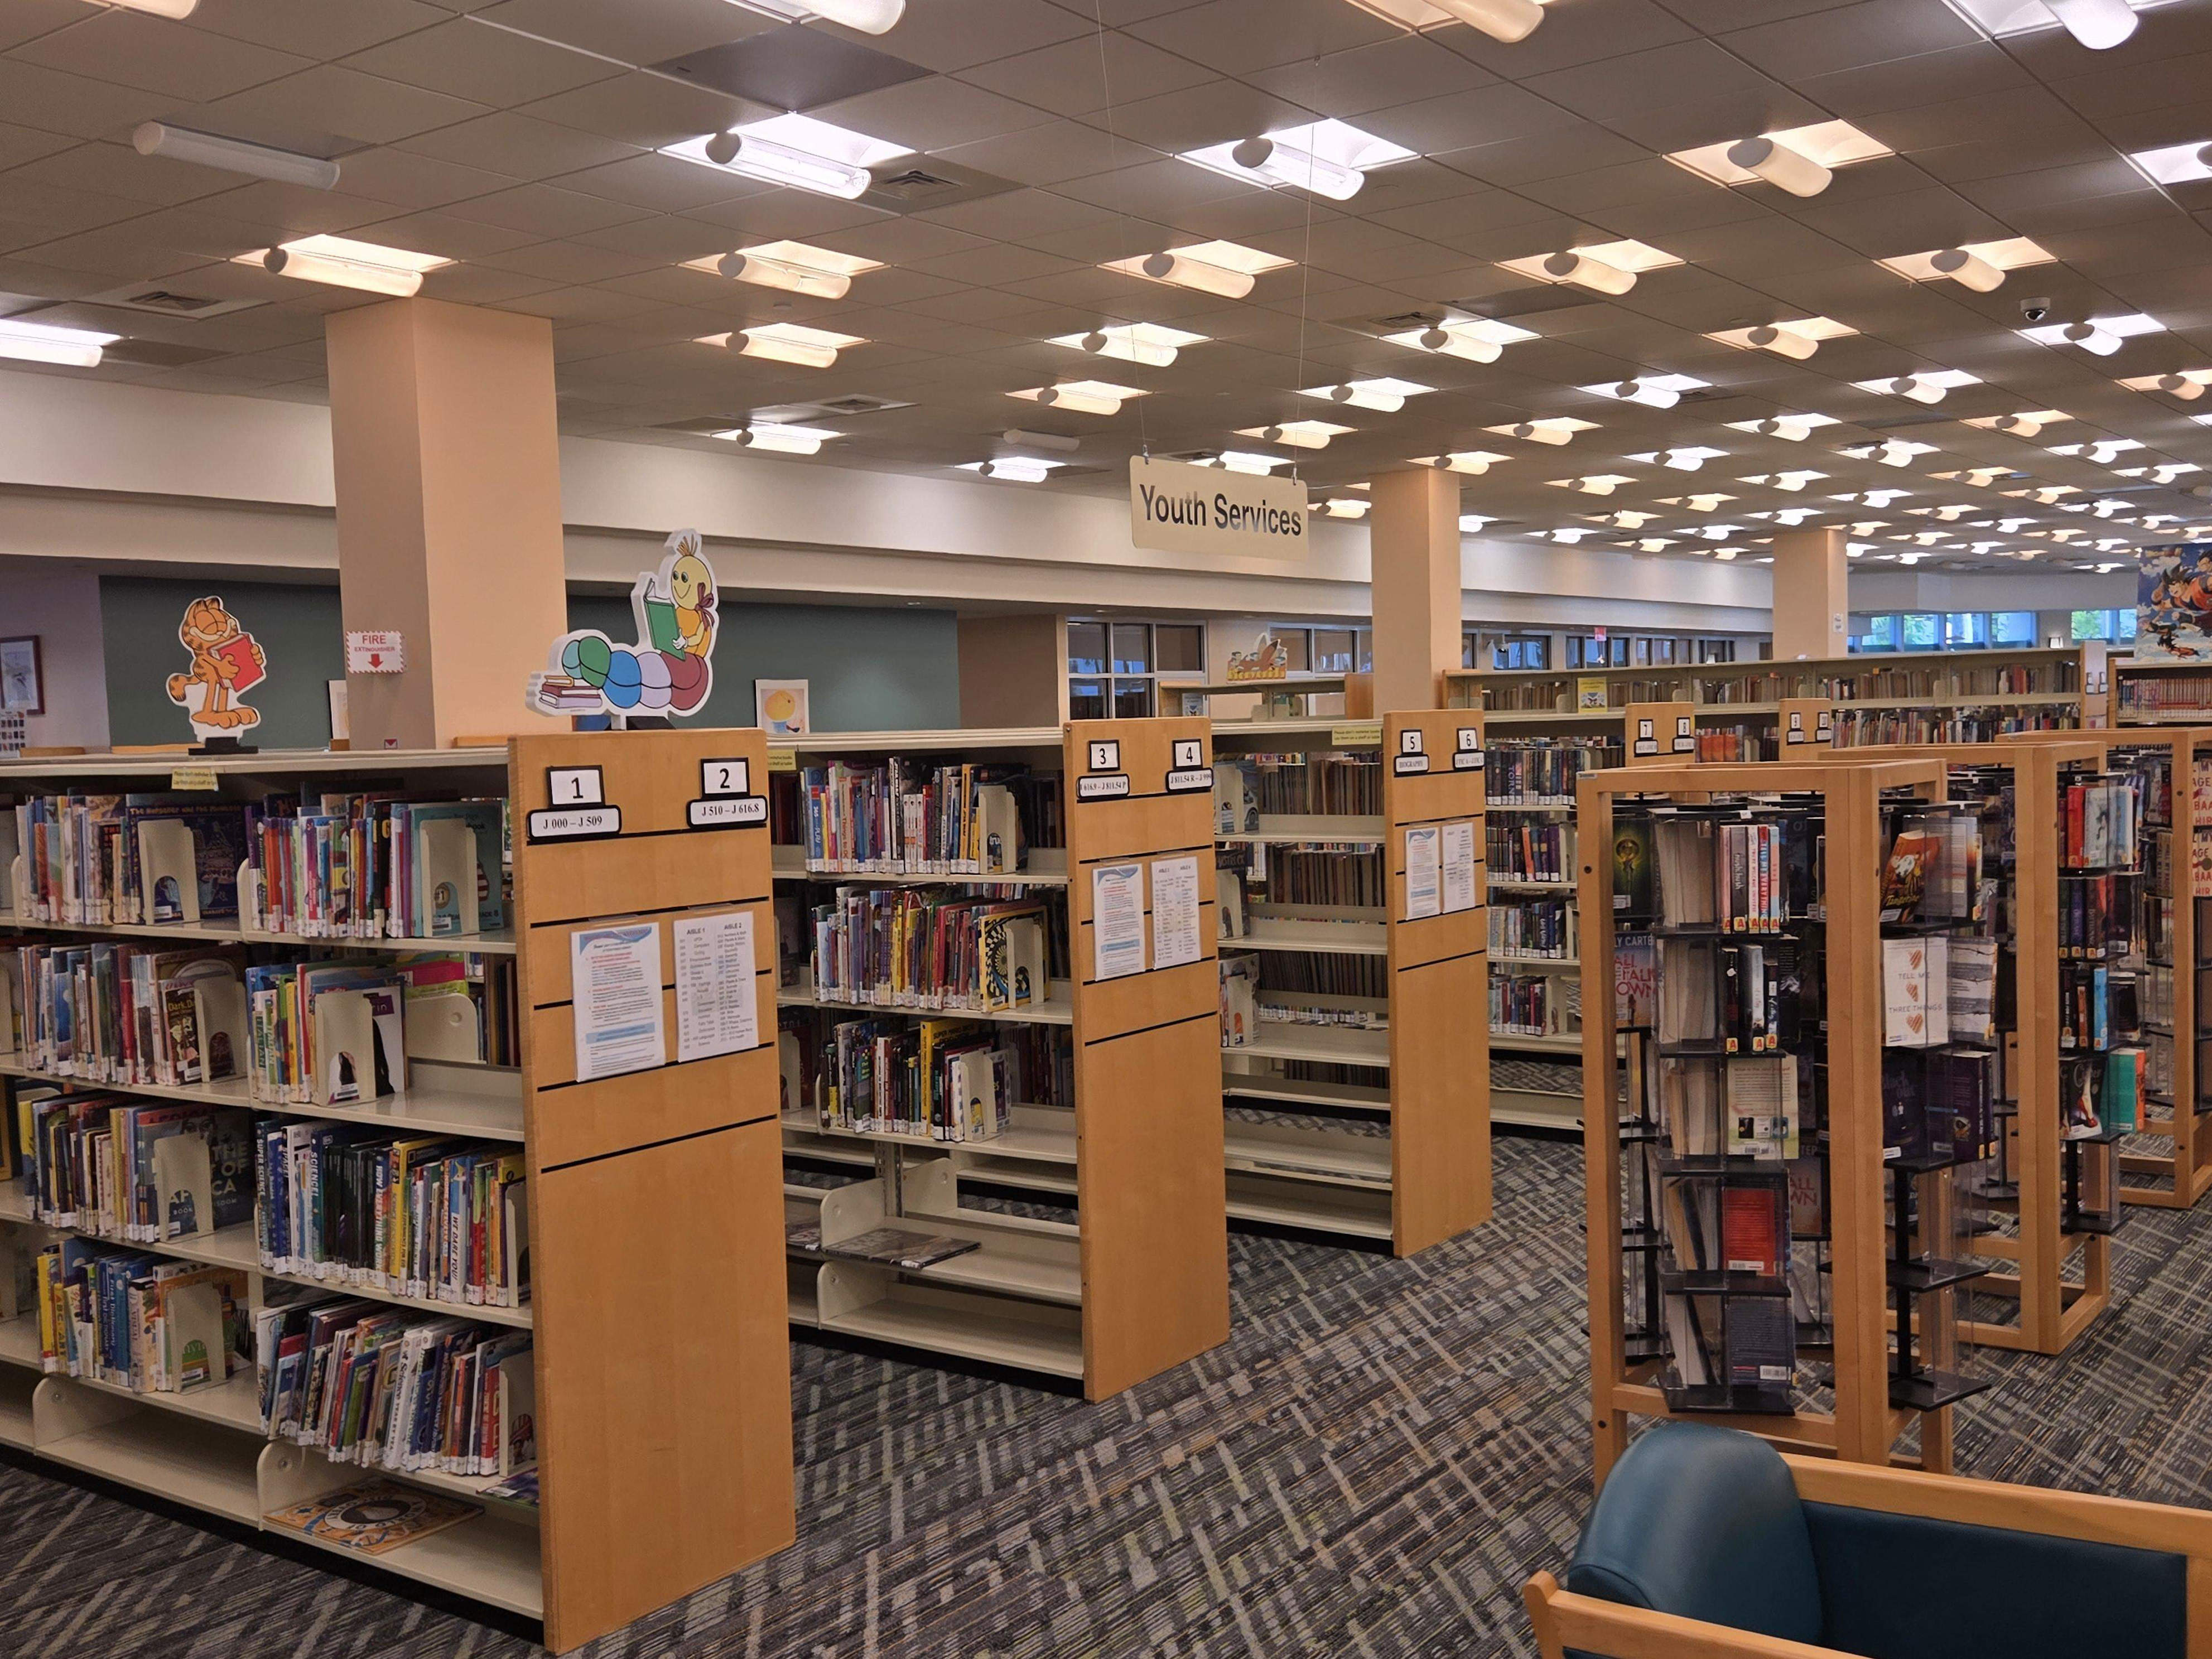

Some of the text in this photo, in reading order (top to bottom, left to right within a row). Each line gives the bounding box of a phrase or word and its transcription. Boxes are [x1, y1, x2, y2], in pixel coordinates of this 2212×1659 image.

[1140, 484, 1301, 536] Youth Services
[363, 635, 386, 644] FIRE
[1644, 724, 1647, 735] 7
[1410, 736, 1415, 749] 5
[1467, 734, 1471, 746] 6
[1100, 747, 1106, 764] 3
[1186, 747, 1193, 762] 4
[720, 768, 730, 789] 2
[571, 778, 584, 799] 1
[702, 807, 707, 817] J
[710, 806, 722, 816] 510
[732, 805, 736, 814] J
[543, 819, 548, 830] J
[552, 818, 567, 828] 000
[579, 818, 584, 827] J
[586, 816, 602, 827] 509
[168, 1001, 186, 1011] Dark
[257, 1017, 265, 1068] ITALIAN
[1730, 1040, 1737, 1049] A
[1757, 1039, 1763, 1049] A
[1768, 1035, 1775, 1045] A
[310, 1151, 319, 1197] SCIENCE!
[452, 1216, 459, 1228] WE
[395, 1362, 408, 1400] Science
[392, 1424, 397, 1434] BY
